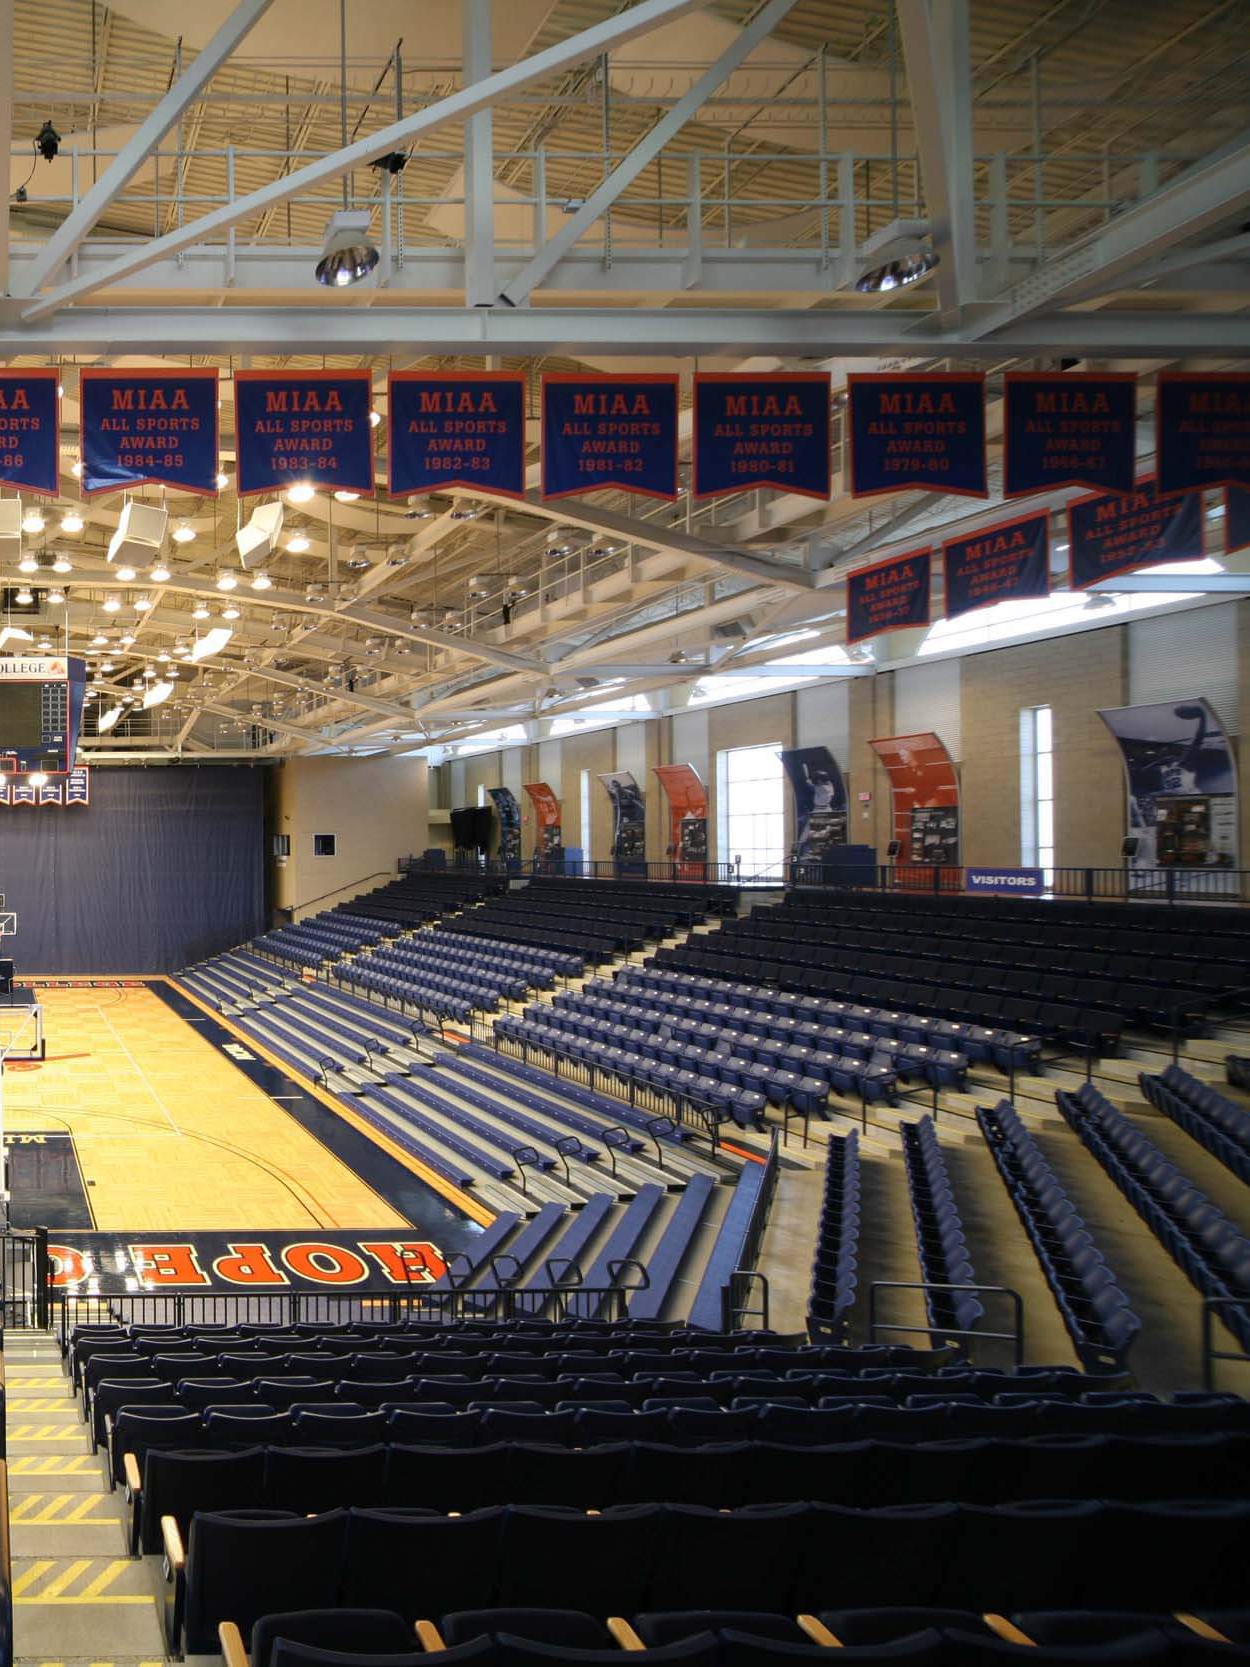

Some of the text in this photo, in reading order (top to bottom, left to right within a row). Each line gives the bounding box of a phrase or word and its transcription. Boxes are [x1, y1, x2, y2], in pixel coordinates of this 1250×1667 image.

[111, 389, 189, 410] MIAA
[266, 391, 343, 412] MIAA
[419, 392, 497, 413] MIAA
[574, 394, 650, 415] MIAA
[725, 395, 803, 416] MIAA
[879, 392, 957, 414] MIAA
[101, 417, 200, 431] ALL SPORTS
[255, 419, 353, 433] ALL SPORTS
[409, 420, 507, 433] ALL SPORTS
[562, 422, 661, 435] ALL SPORTS
[714, 423, 814, 437] ALL SPORTS
[868, 421, 967, 435] ALL SPORTS
[119, 436, 179, 449] AWARD
[273, 438, 333, 451] AWARD
[428, 439, 486, 452] AWARD
[582, 440, 640, 453] AWARD
[733, 441, 794, 454] AWARD
[886, 440, 945, 453] AWARD
[117, 454, 184, 468] 1984-85
[271, 456, 337, 470] 1983-84
[424, 457, 490, 470] 1982-83
[964, 531, 1026, 562] MIAA
[971, 875, 1037, 887] VISITORS
[128, 1241, 449, 1286] HOPE
